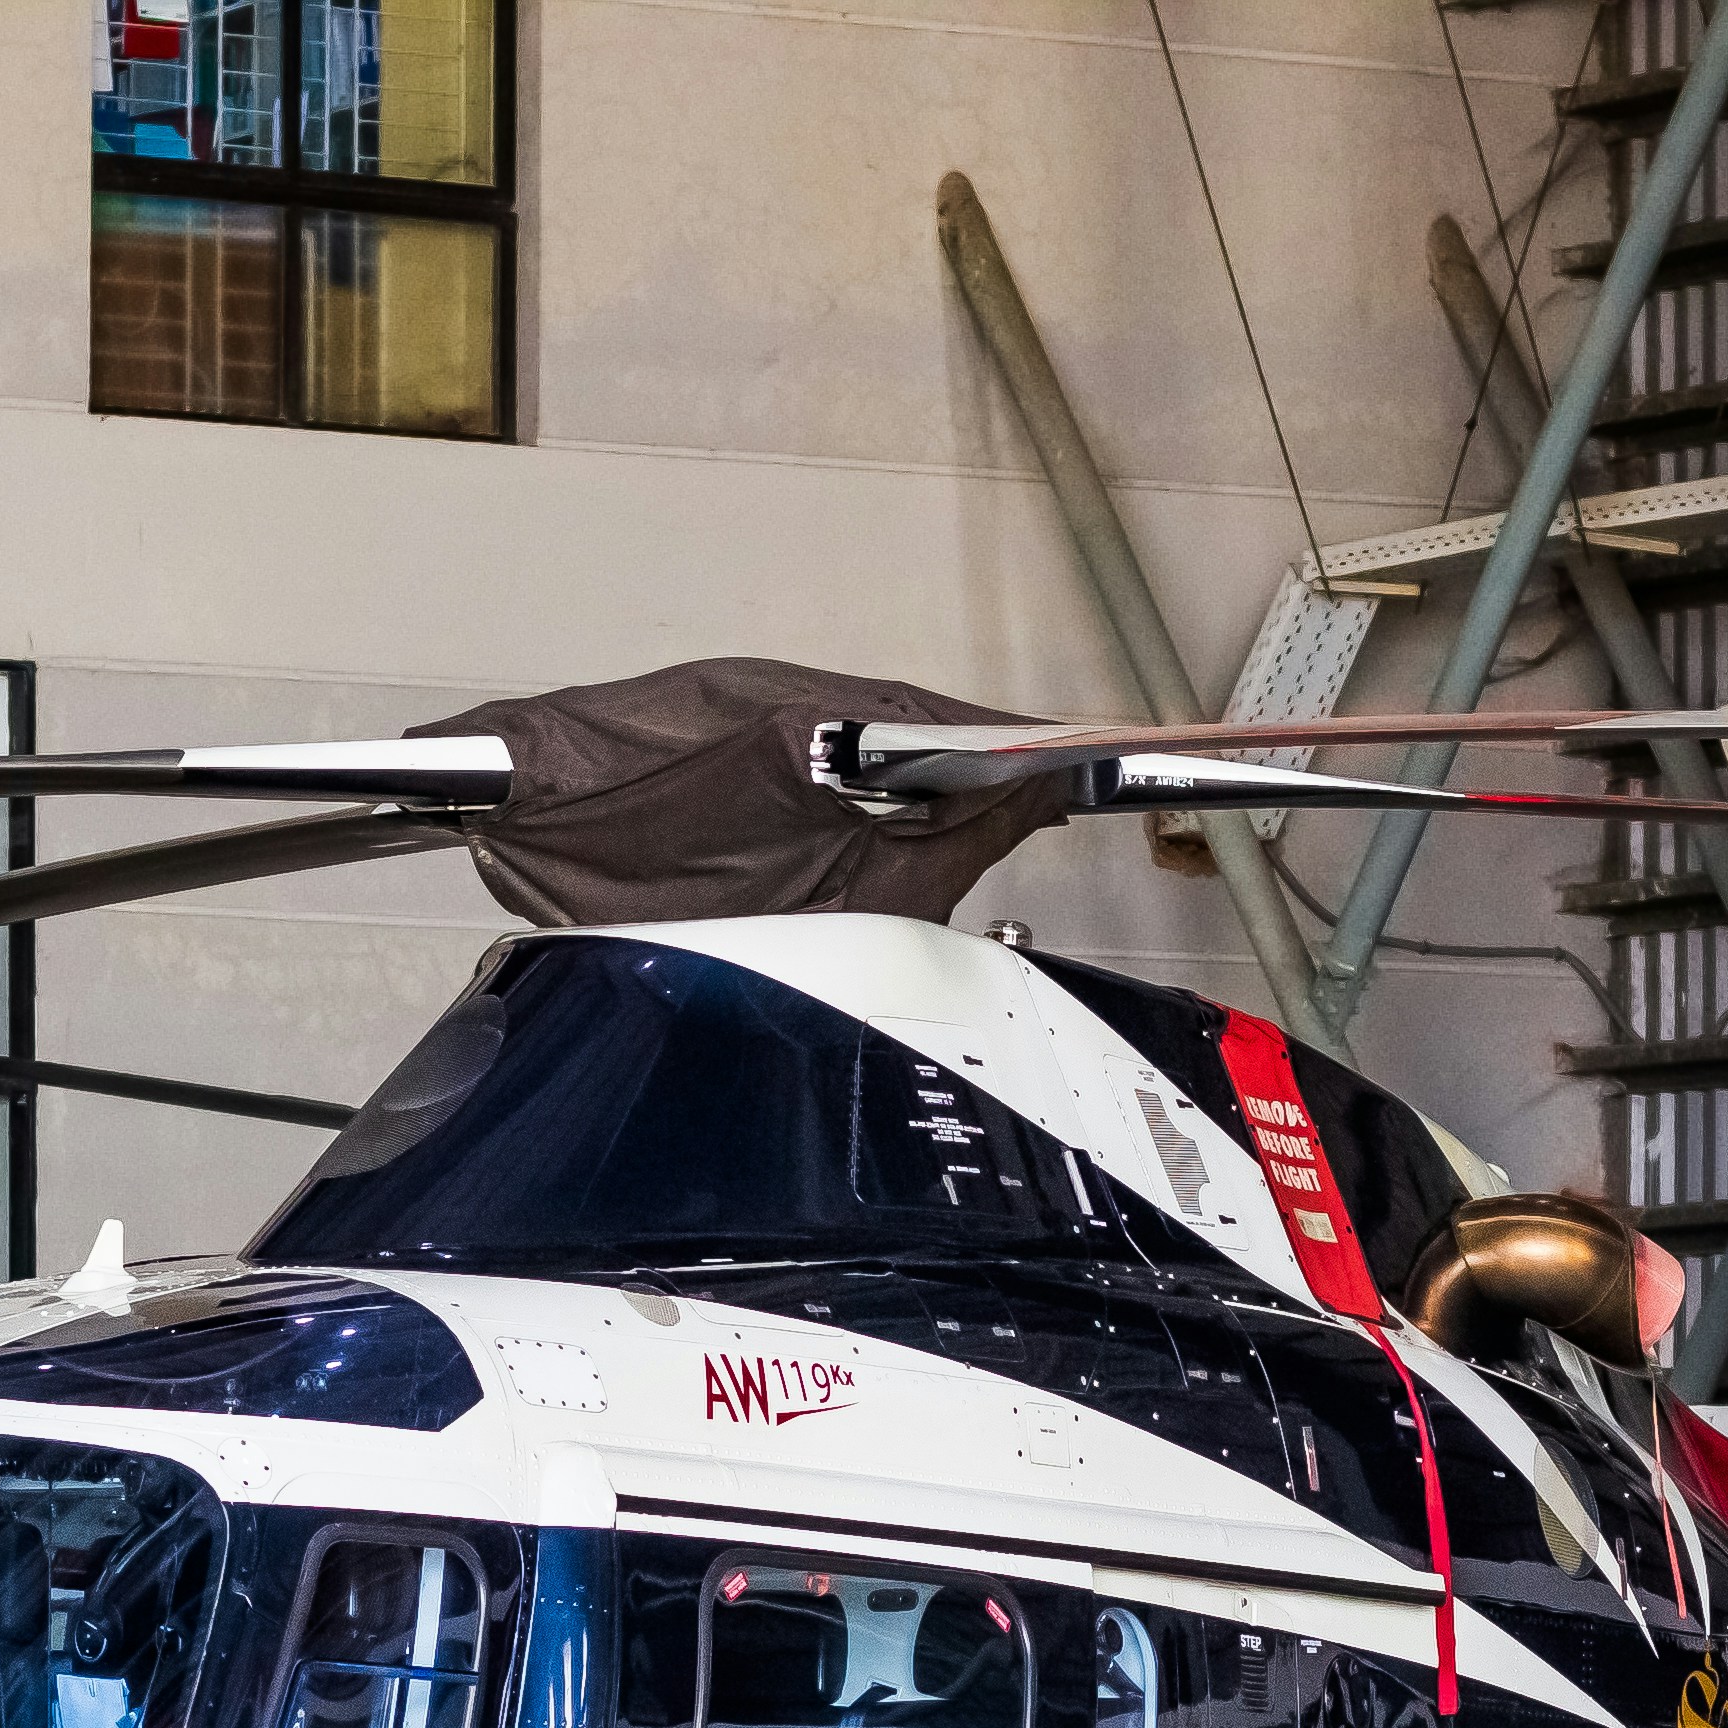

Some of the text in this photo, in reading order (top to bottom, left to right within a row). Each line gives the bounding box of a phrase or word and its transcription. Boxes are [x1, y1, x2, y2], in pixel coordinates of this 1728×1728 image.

[1255, 1126, 1316, 1161] BEFORE
[1270, 1159, 1322, 1192] FLIGHT
[1240, 1634, 1262, 1649] STEP
